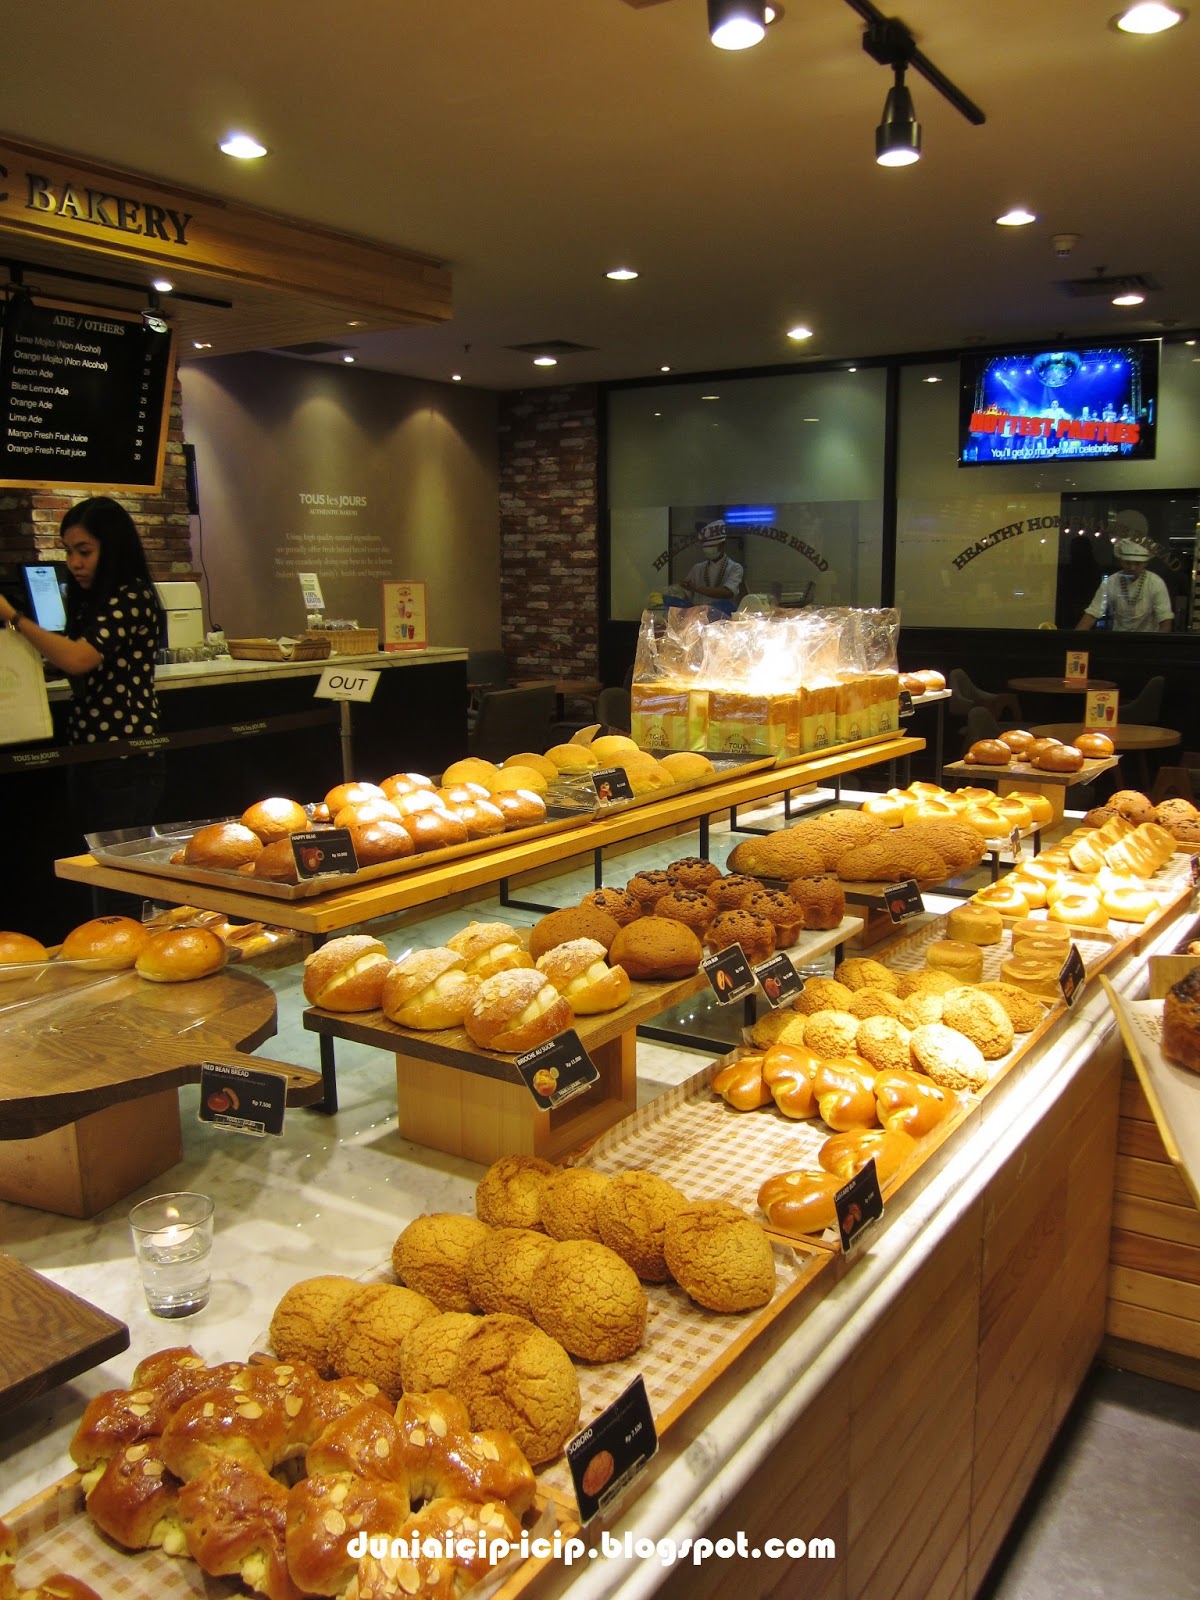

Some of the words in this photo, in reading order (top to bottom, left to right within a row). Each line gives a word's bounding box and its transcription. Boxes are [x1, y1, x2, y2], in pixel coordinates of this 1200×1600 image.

[26, 173, 192, 245] BAKERY
[53, 316, 75, 328] ADE
[84, 320, 126, 336] OTHERS
[15, 334, 33, 344] Lime
[34, 336, 56, 348] Mojito
[57, 340, 74, 350] (Non
[74, 343, 102, 355] Alcohol)
[14, 350, 41, 363] Orange
[42, 354, 64, 365] Mojito
[64, 356, 81, 368] (Non
[82, 360, 108, 372] Alcohol)
[12, 366, 38, 376] Lemon
[38, 369, 54, 379] Ade
[12, 382, 28, 392] Blue
[29, 384, 54, 394] Lemon
[54, 386, 69, 396] Ade
[10, 397, 37, 409] Orange
[38, 400, 53, 410] Ade
[9, 412, 27, 422] Lime
[28, 414, 42, 424] Ade
[8, 428, 32, 439] Mango
[34, 430, 54, 440] Fresh
[54, 432, 70, 442] Fruit
[70, 434, 88, 443] Juice
[7, 443, 34, 454] Orange
[34, 446, 54, 455] Fresh
[56, 447, 70, 456] Fruit
[136, 439, 142, 447] 30
[134, 453, 141, 461] 30
[991, 447, 1010, 458] You'll
[1012, 448, 1024, 458] get
[1025, 447, 1034, 457] to
[1034, 446, 1060, 459] mingle
[1062, 444, 1078, 455] with
[1079, 443, 1118, 454] celebrities
[299, 494, 325, 505] TOUS
[326, 494, 338, 506] les
[338, 495, 367, 508] JOURS
[952, 521, 1024, 571] HEALTHY
[787, 535, 829, 573] BREAD
[329, 675, 369, 691] OUT
[152, 736, 170, 744] JOURS
[650, 733, 664, 741] TOUS
[650, 739, 670, 747] JOURS
[12, 754, 31, 762] TOUS
[40, 751, 60, 760] JOURS
[516, 1051, 536, 1066] BRIOCHE
[203, 1064, 214, 1072] RED
[214, 1065, 230, 1074] BEAN
[230, 1068, 250, 1078] BREAD
[569, 1428, 593, 1455] SOBORO
[625, 1435, 632, 1444] Rp
